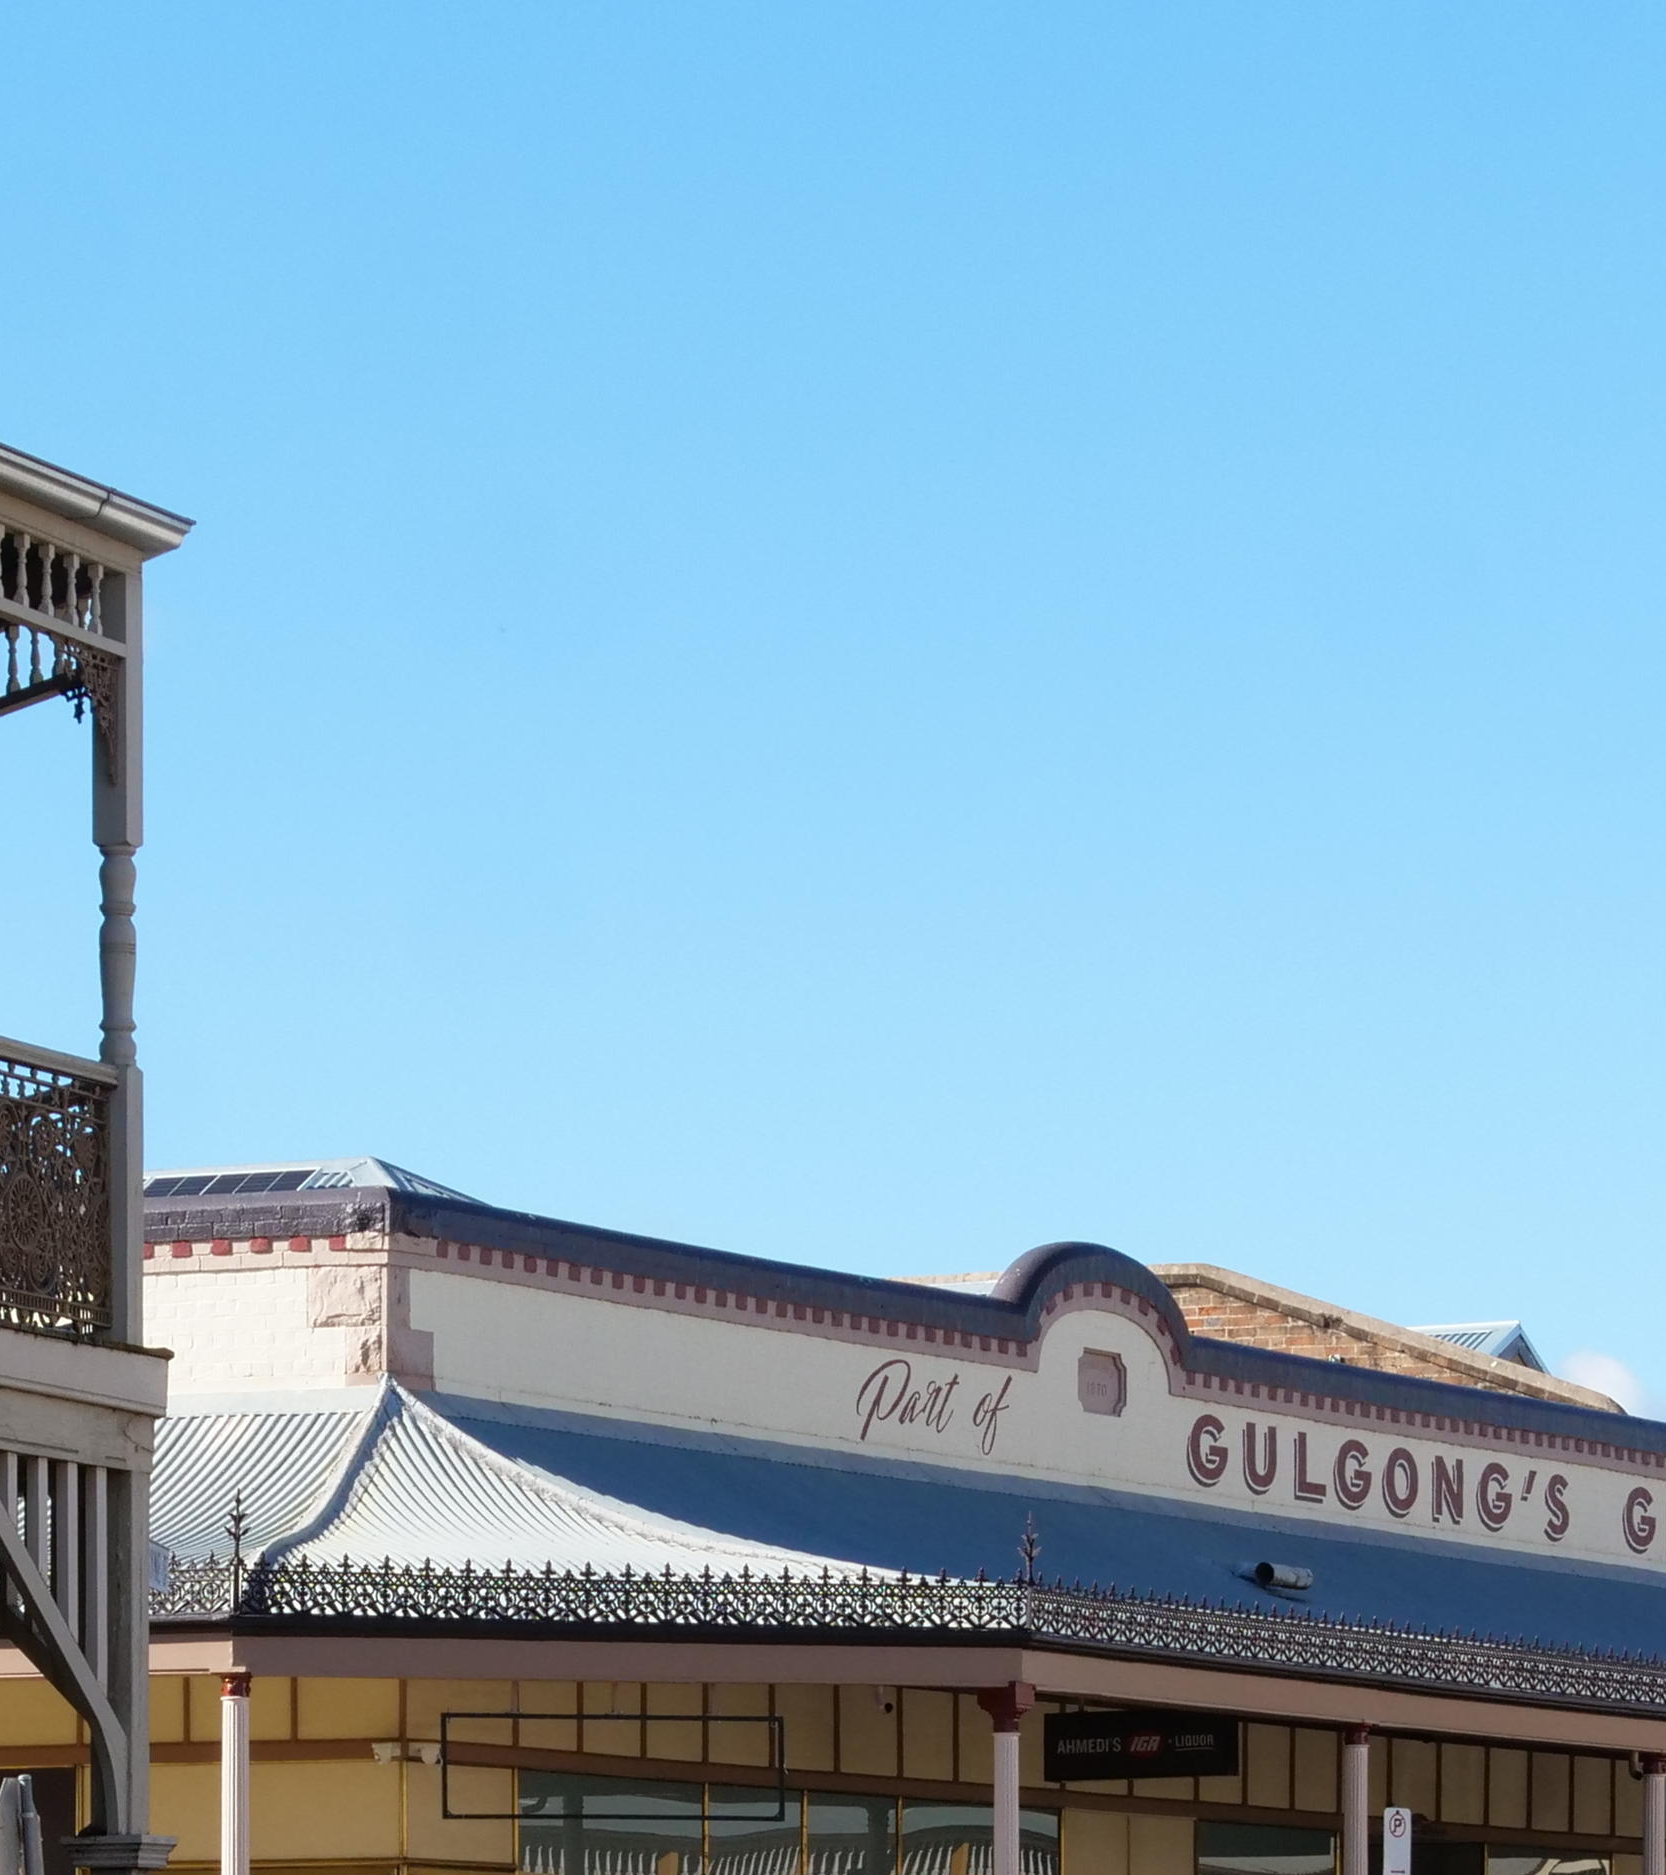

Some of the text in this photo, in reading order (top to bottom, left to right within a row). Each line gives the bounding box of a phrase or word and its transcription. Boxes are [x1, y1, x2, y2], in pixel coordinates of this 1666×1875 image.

[855, 1359, 1013, 1455] Part of
[1186, 1414, 1571, 1542] GULGONG'S
[1056, 1736, 1122, 1754] AHMEDI'S
[1130, 1735, 1161, 1752] IGA
[1174, 1733, 1214, 1748] LIQUOR
